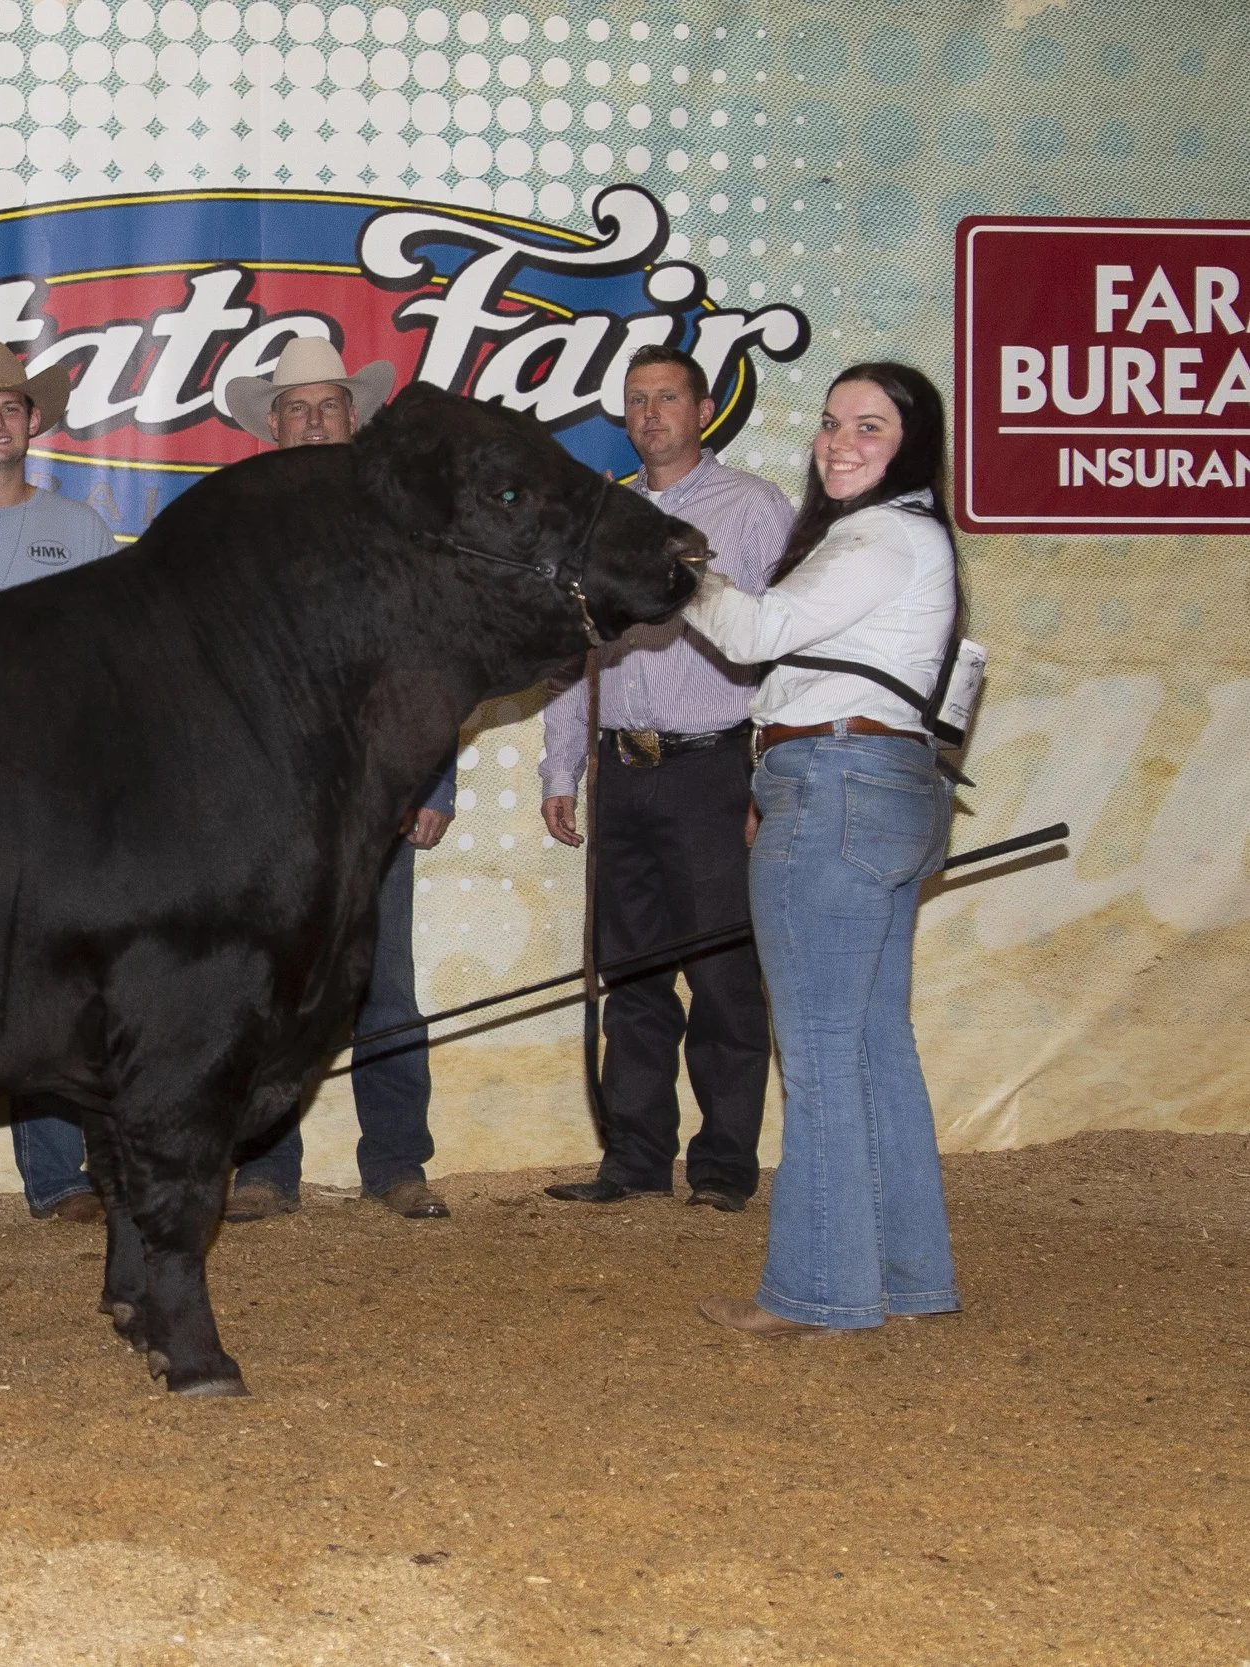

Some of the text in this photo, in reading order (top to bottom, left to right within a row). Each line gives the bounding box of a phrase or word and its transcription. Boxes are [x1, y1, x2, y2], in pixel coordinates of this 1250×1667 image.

[358, 184, 804, 424] Fair
[1096, 265, 1250, 335] FAR
[31, 546, 67, 559] HMK
